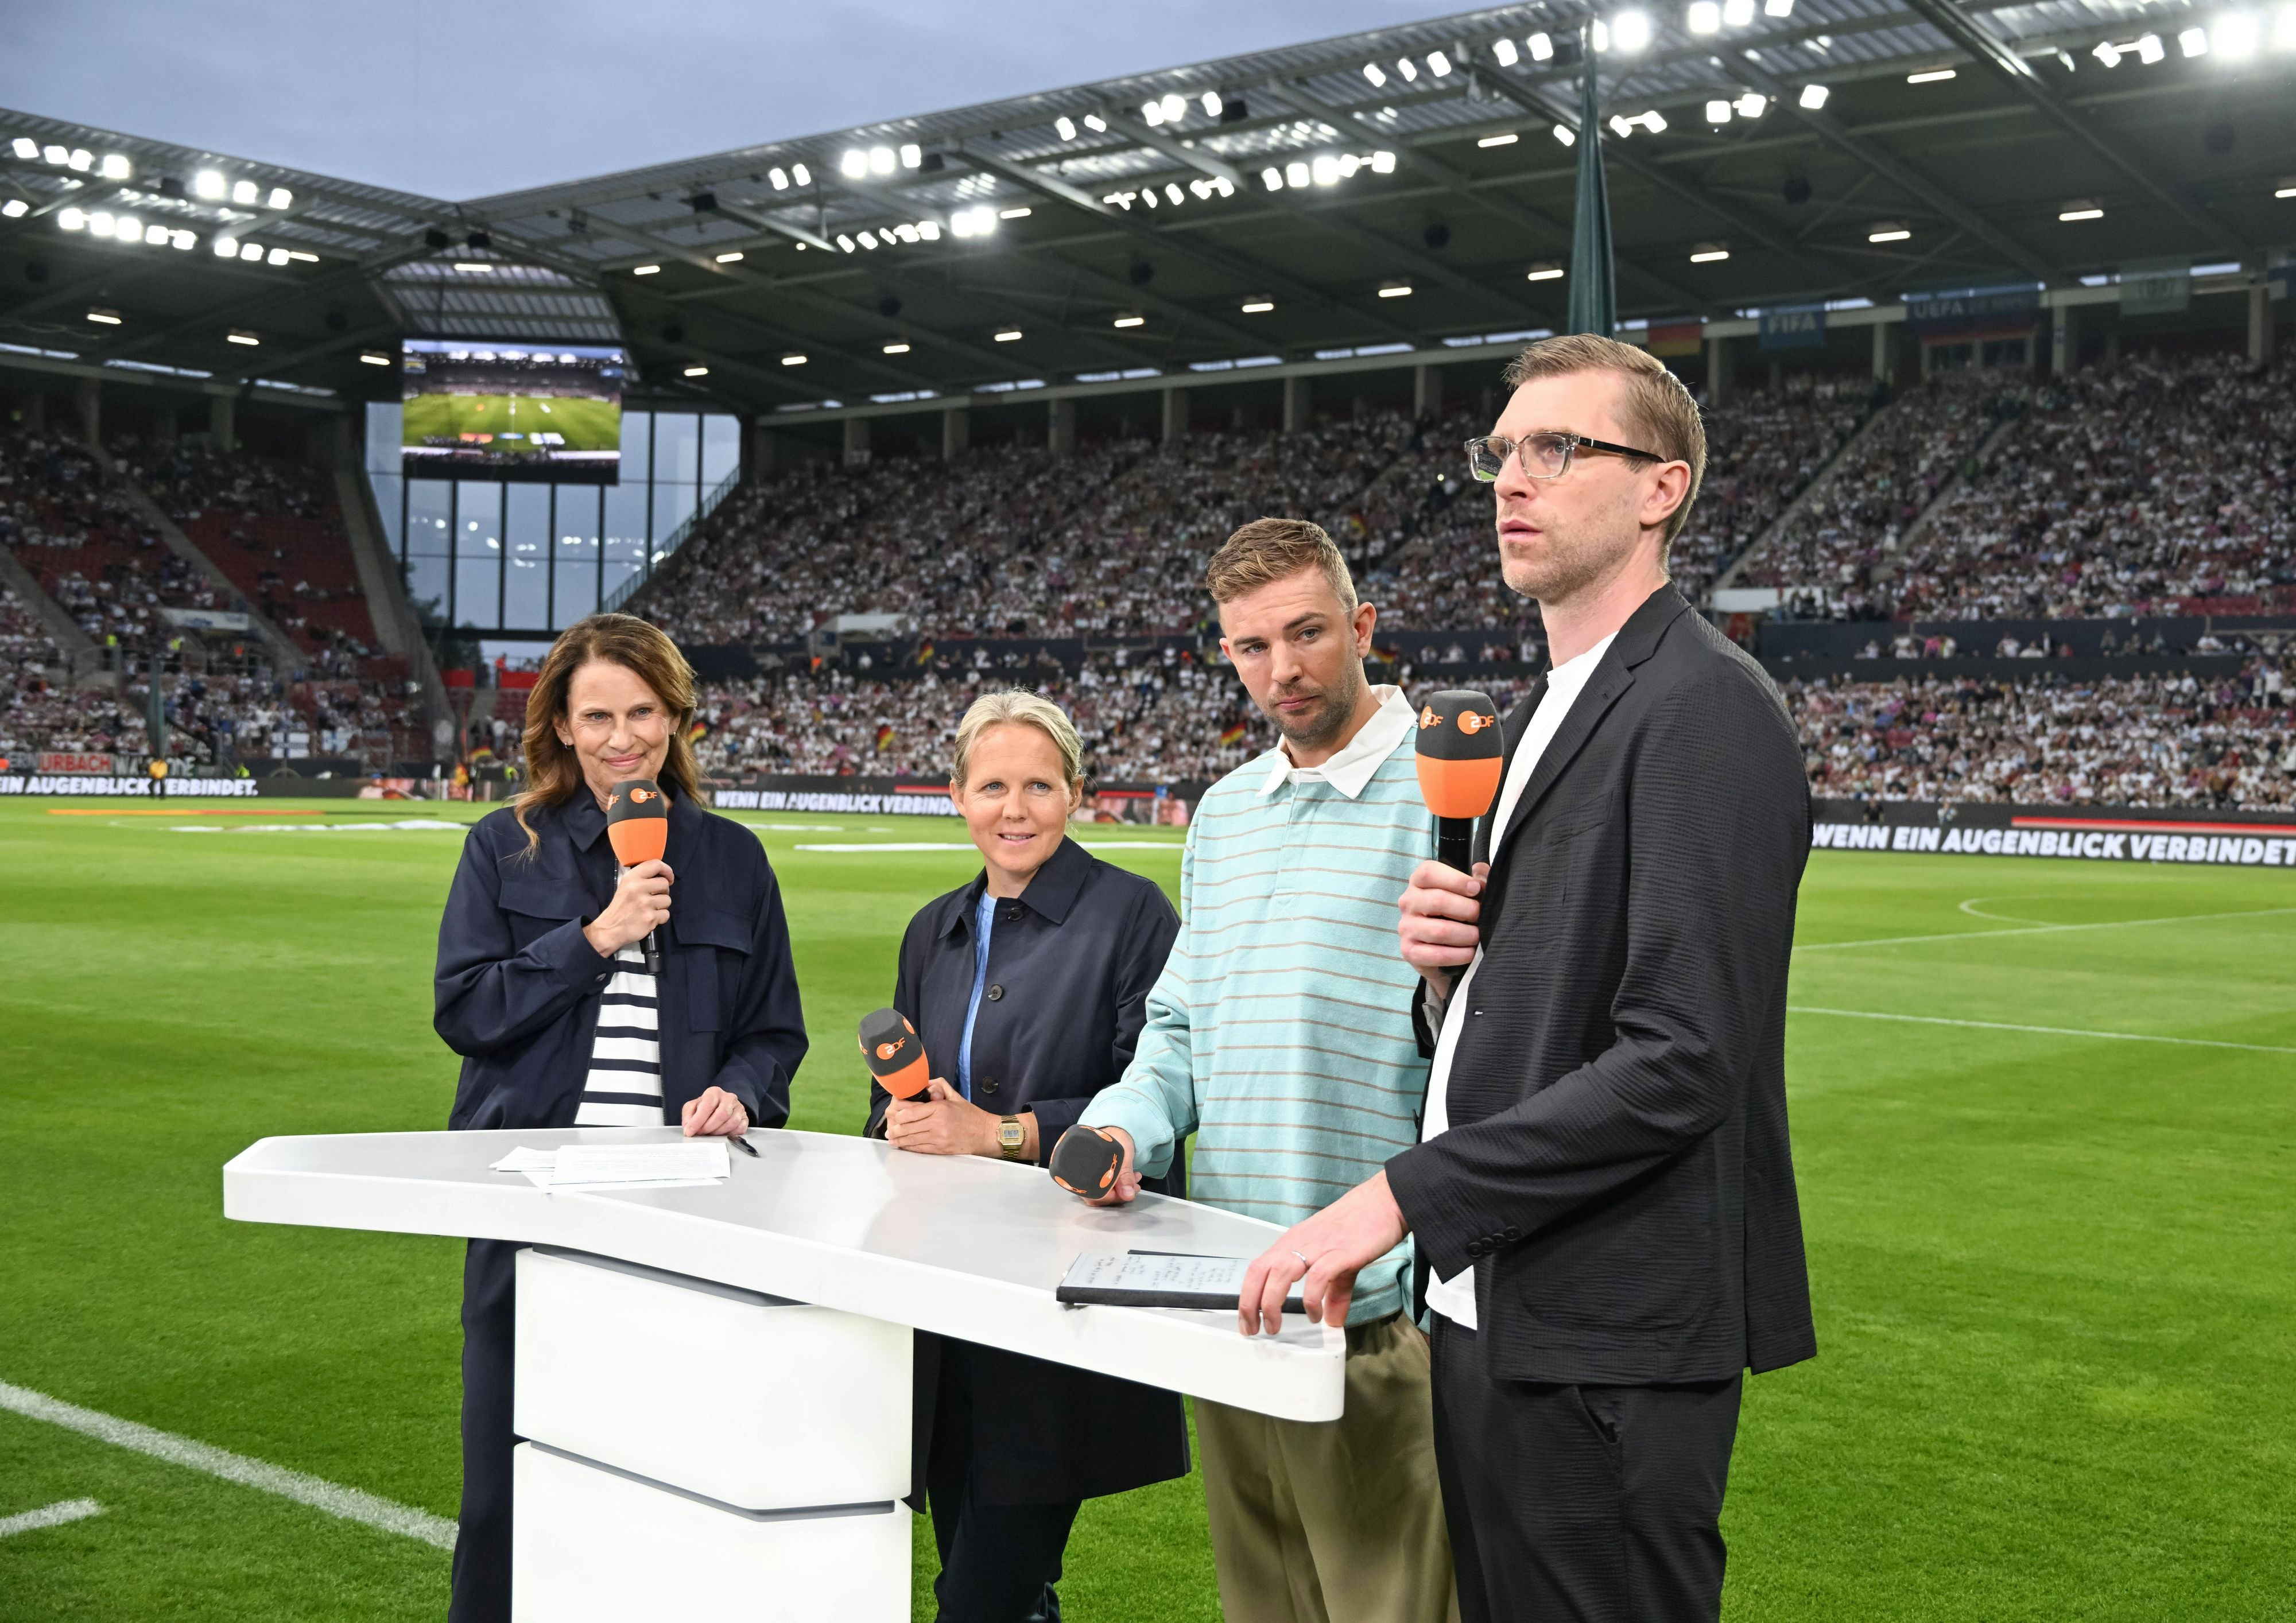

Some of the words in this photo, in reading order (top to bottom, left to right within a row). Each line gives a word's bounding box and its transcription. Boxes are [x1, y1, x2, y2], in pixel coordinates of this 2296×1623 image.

[1768, 313, 1815, 334] FIFA
[40, 754, 111, 772] URBACH
[25, 776, 152, 795] AUGENBLICK
[715, 790, 759, 809] WENN
[759, 791, 788, 809] EIN
[786, 793, 882, 813] AUGENBLICK
[1811, 823, 1890, 849] WENN
[1891, 826, 1940, 852] EIN
[1940, 828, 2126, 859] AUGENBLICK
